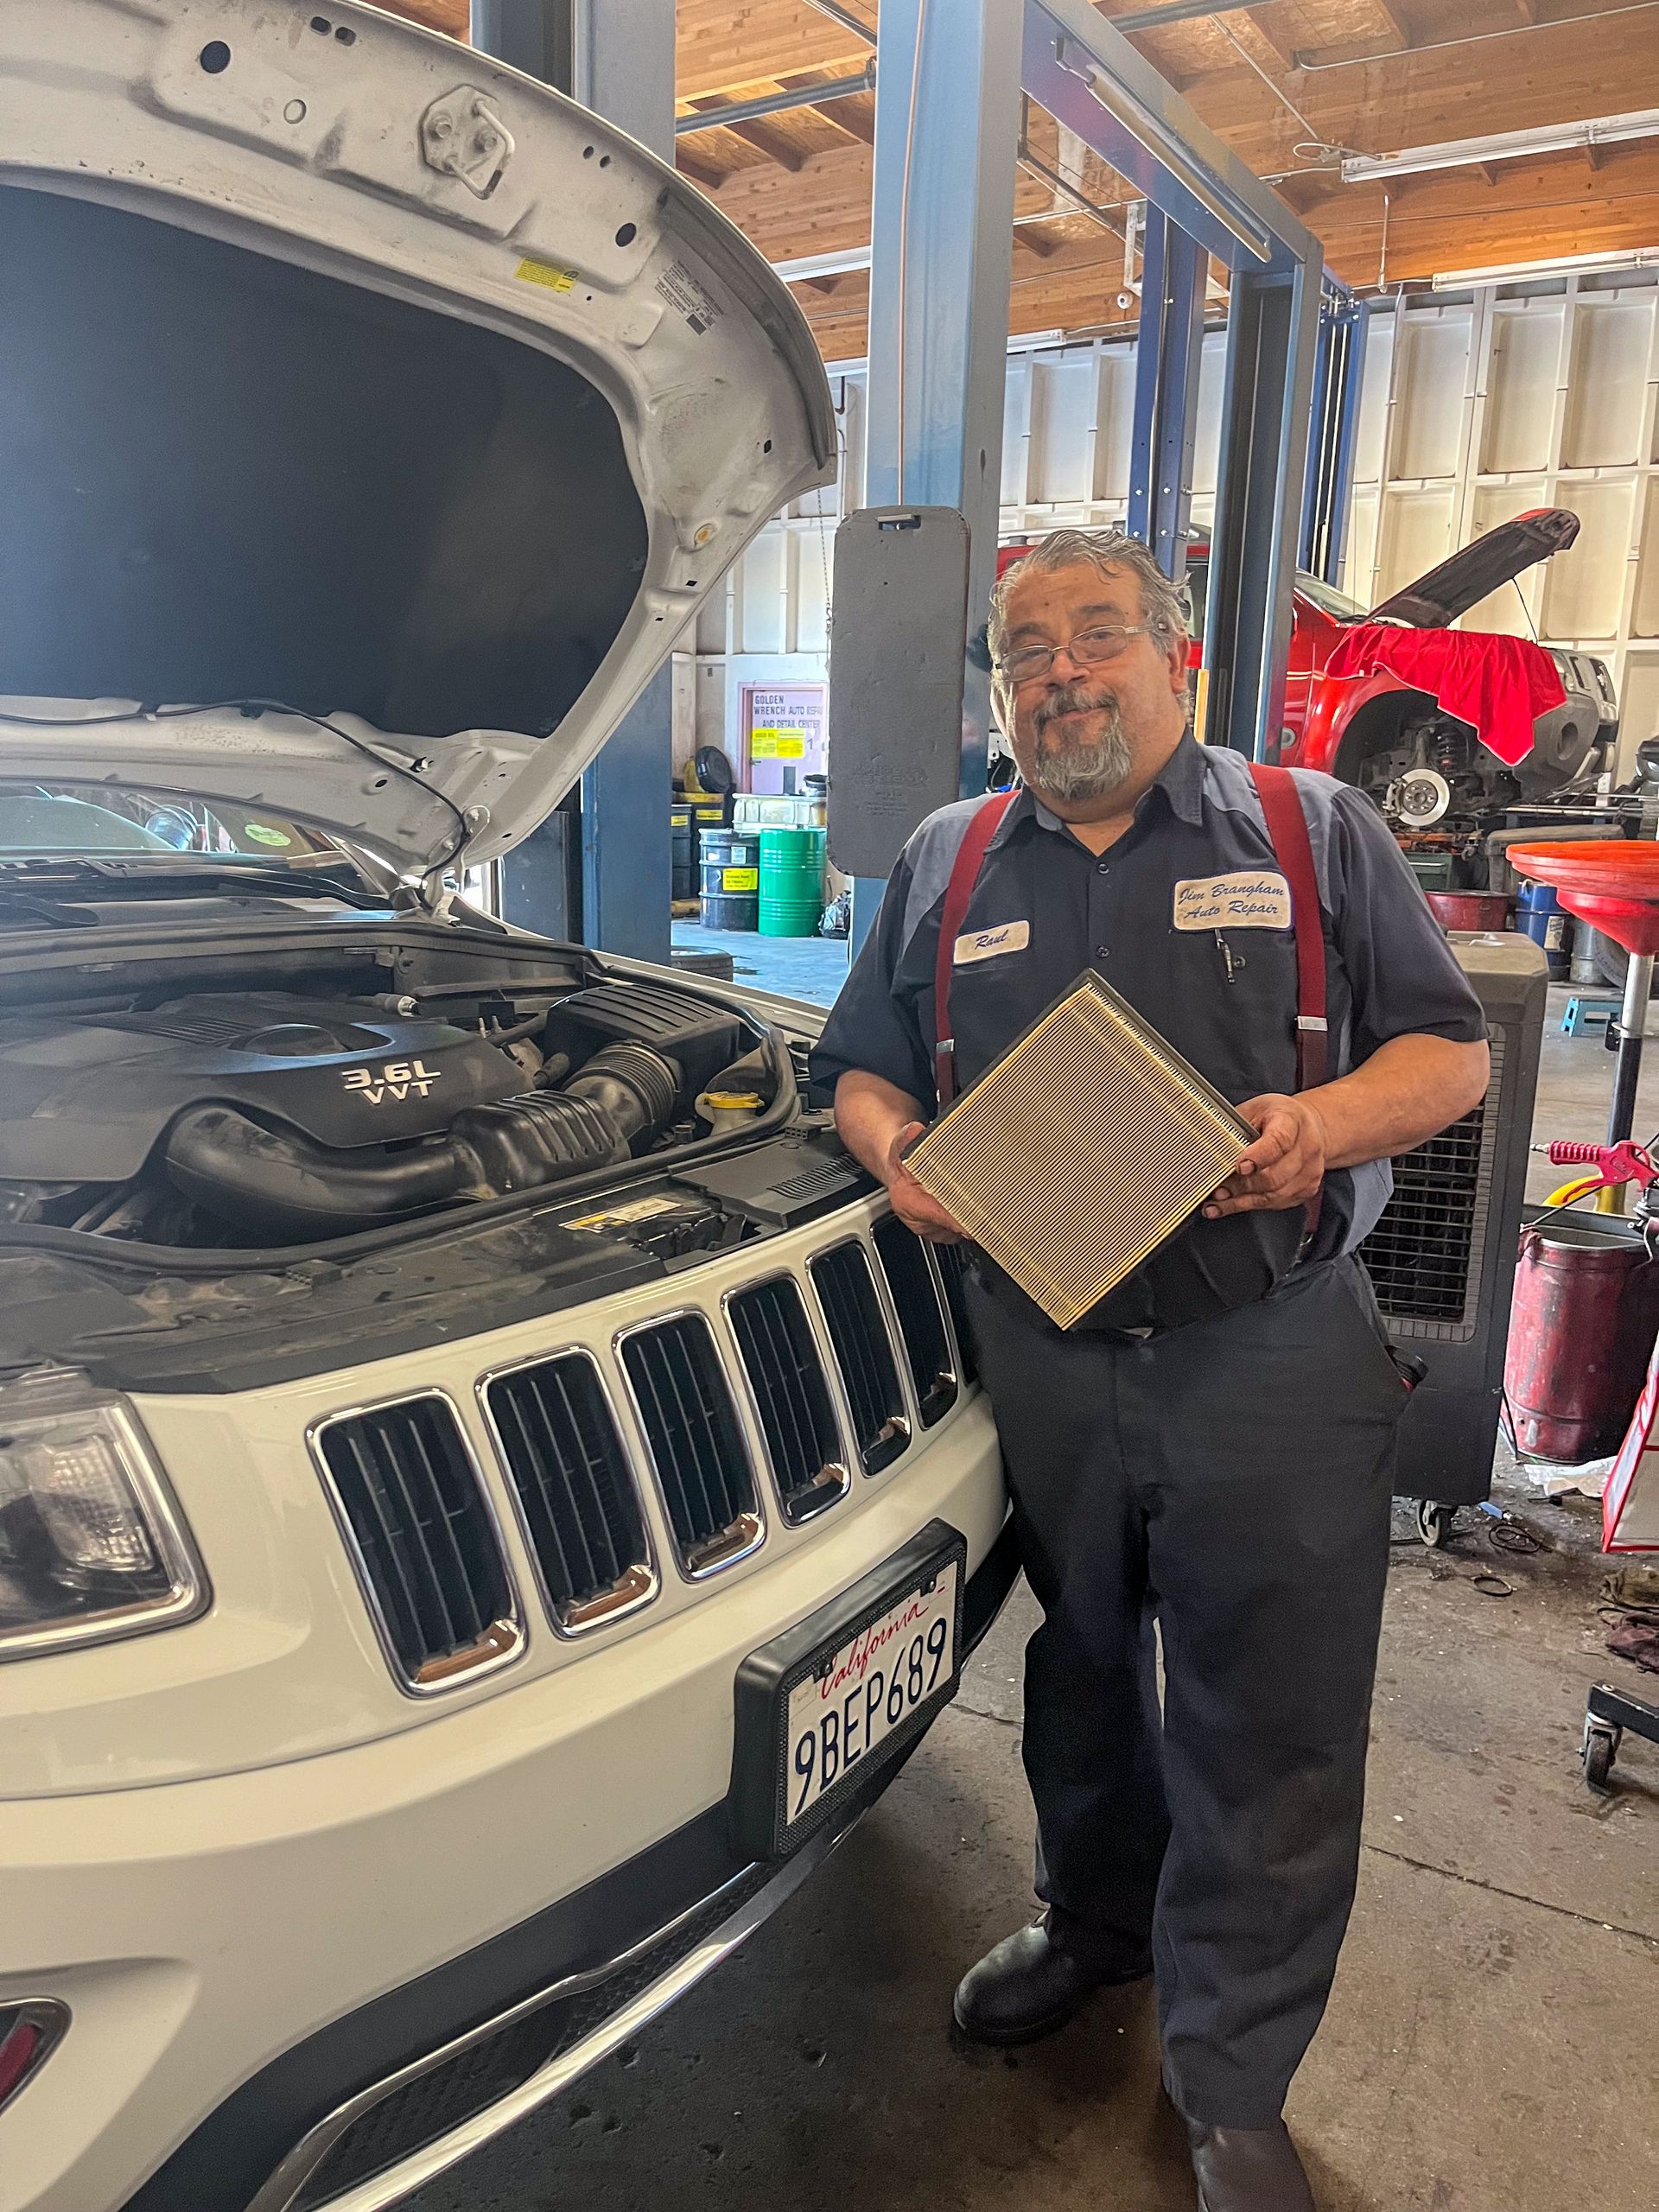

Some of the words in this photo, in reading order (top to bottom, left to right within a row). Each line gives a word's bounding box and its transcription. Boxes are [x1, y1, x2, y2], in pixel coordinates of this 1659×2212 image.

[753, 706, 785, 715] WRENCH
[788, 706, 804, 715] AUTO
[754, 695, 784, 705] GOLDEN
[1178, 888, 1205, 905] Jim
[1211, 880, 1284, 898] Brangham
[1184, 906, 1220, 918] Auto
[1227, 900, 1279, 915] Repair
[975, 929, 1009, 950] Raul
[341, 1059, 442, 1090] 3.6L
[362, 1079, 433, 1104] VVT
[821, 1600, 929, 1700] California
[794, 1617, 947, 1816] 9BEP689
